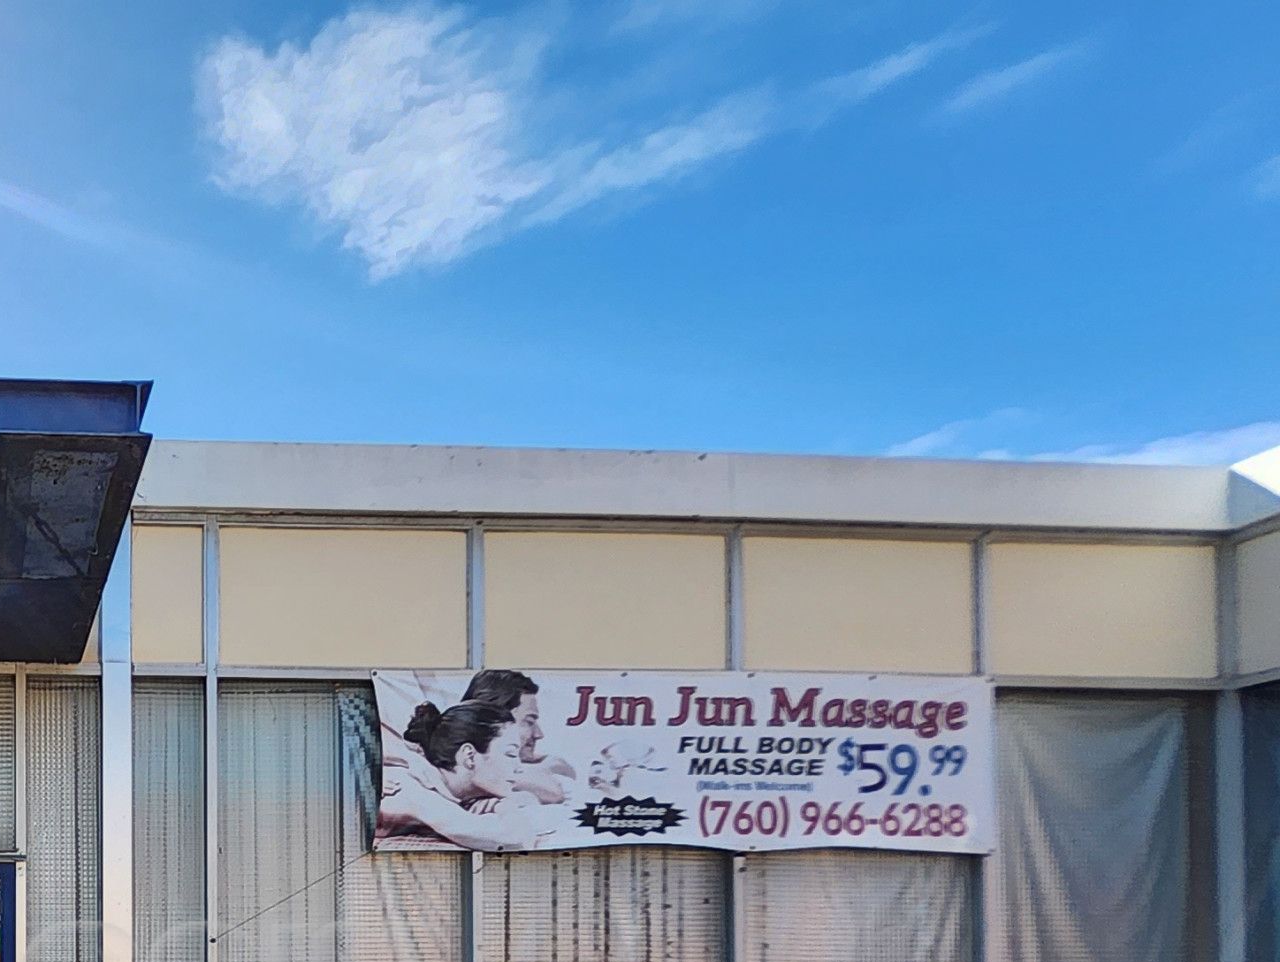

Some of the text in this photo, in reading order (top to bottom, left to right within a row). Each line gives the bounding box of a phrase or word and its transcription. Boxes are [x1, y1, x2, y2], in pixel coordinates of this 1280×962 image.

[566, 686, 968, 738] Jun Jun Massage
[677, 736, 836, 754] FULL BODY
[687, 757, 826, 775] MASSAGE
[593, 804, 620, 816] Hot
[699, 795, 968, 837] (760) 966-6288
